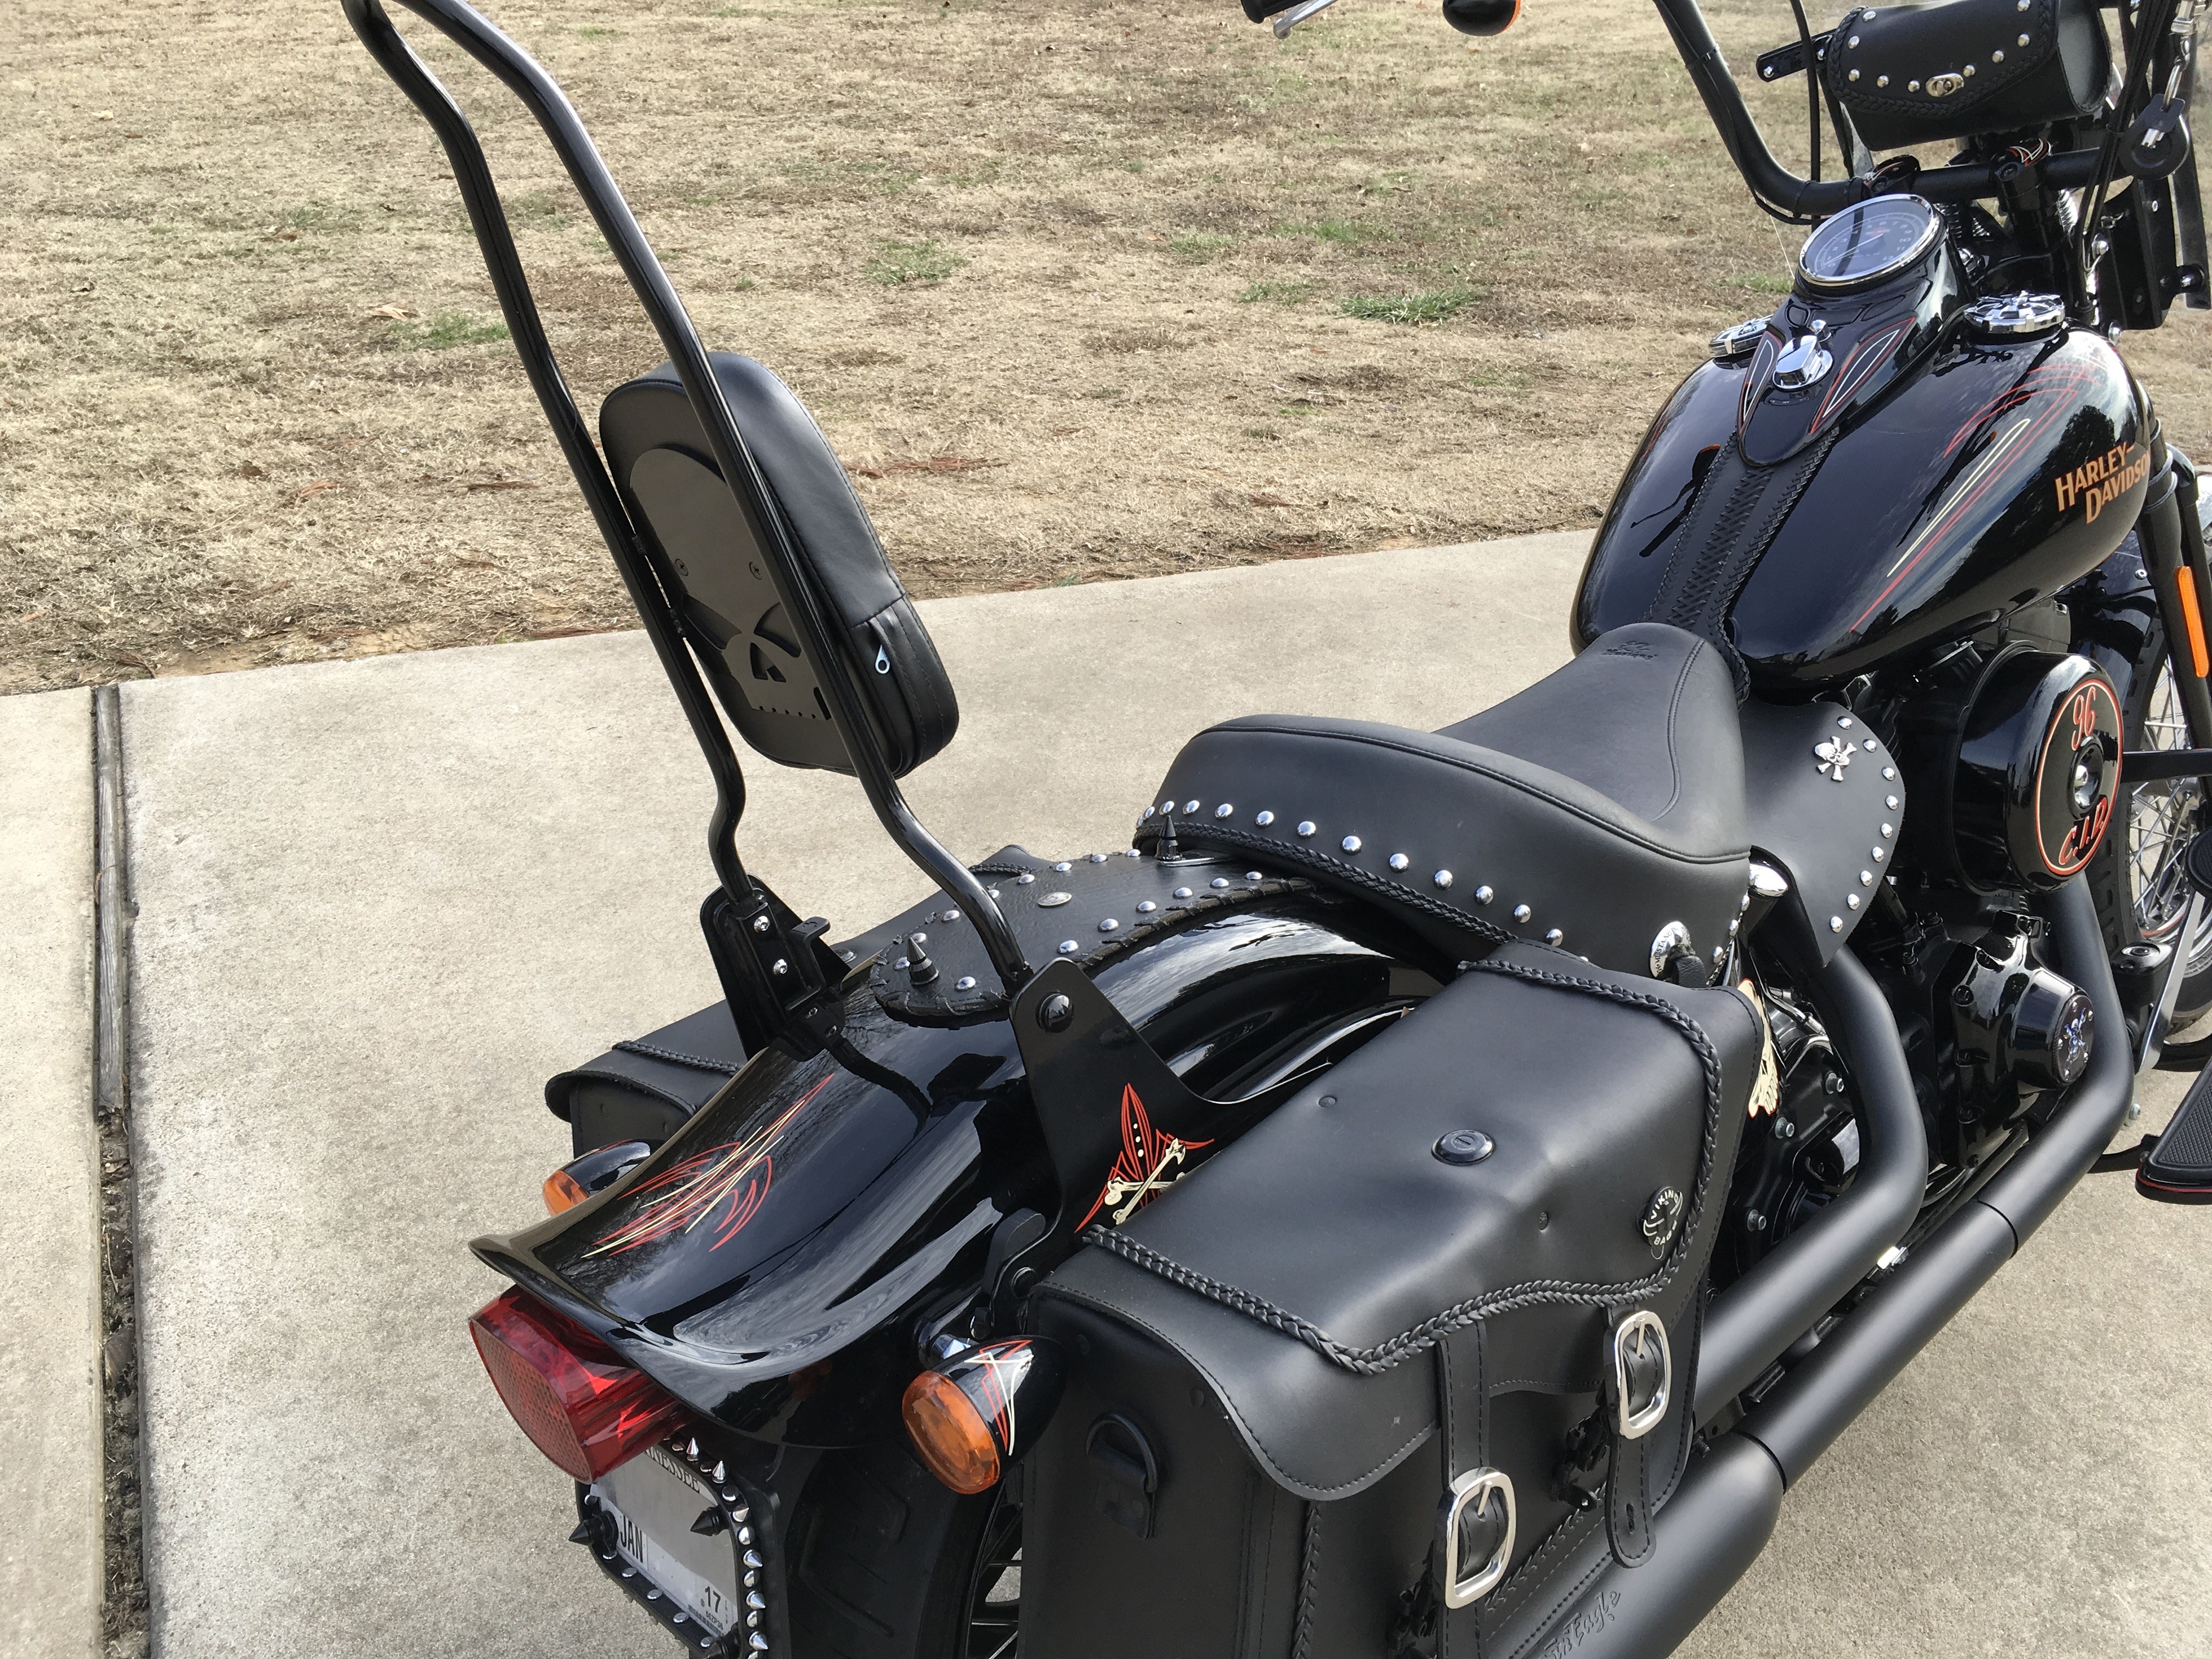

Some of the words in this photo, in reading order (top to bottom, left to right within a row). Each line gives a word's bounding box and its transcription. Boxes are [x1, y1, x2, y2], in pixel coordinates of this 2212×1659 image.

[2055, 441, 2135, 512] HARLEY-
[2085, 450, 2150, 525] DAVIDSO
[2071, 686, 2096, 751] 96
[620, 1515, 644, 1564] JAN
[704, 1585, 721, 1613] 17
